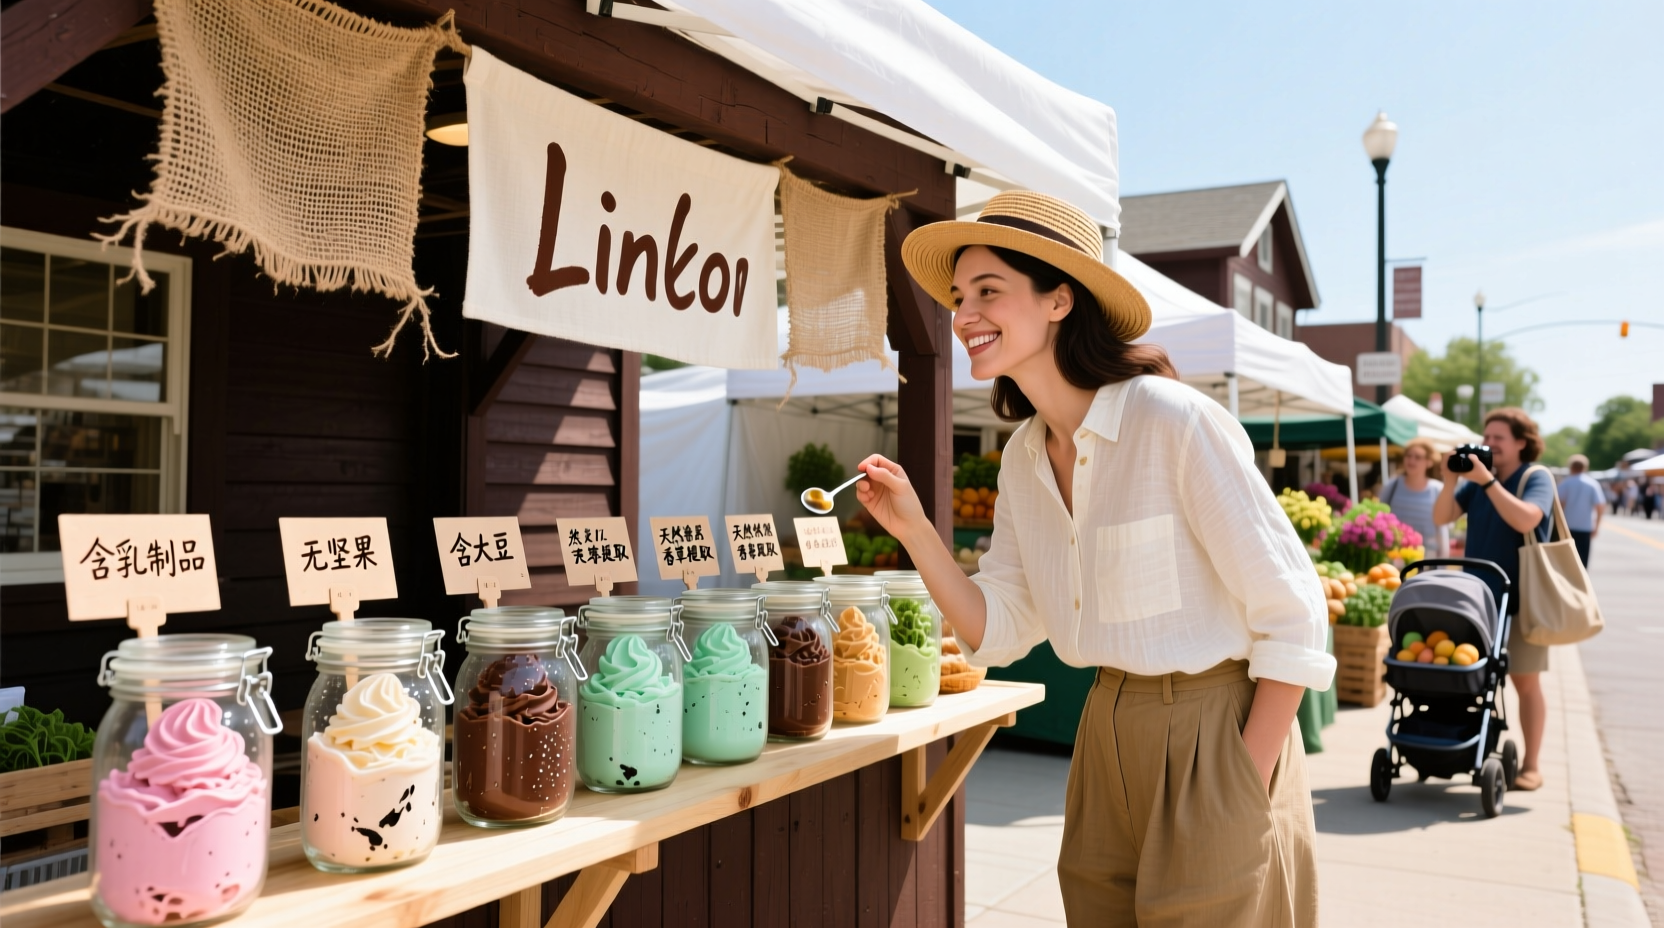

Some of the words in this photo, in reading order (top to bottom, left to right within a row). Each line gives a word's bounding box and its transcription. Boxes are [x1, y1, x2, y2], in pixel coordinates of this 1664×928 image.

[80, 536, 205, 581] 含乳制品
[301, 534, 377, 572] 无坚果
[450, 531, 514, 567] 含大豆
